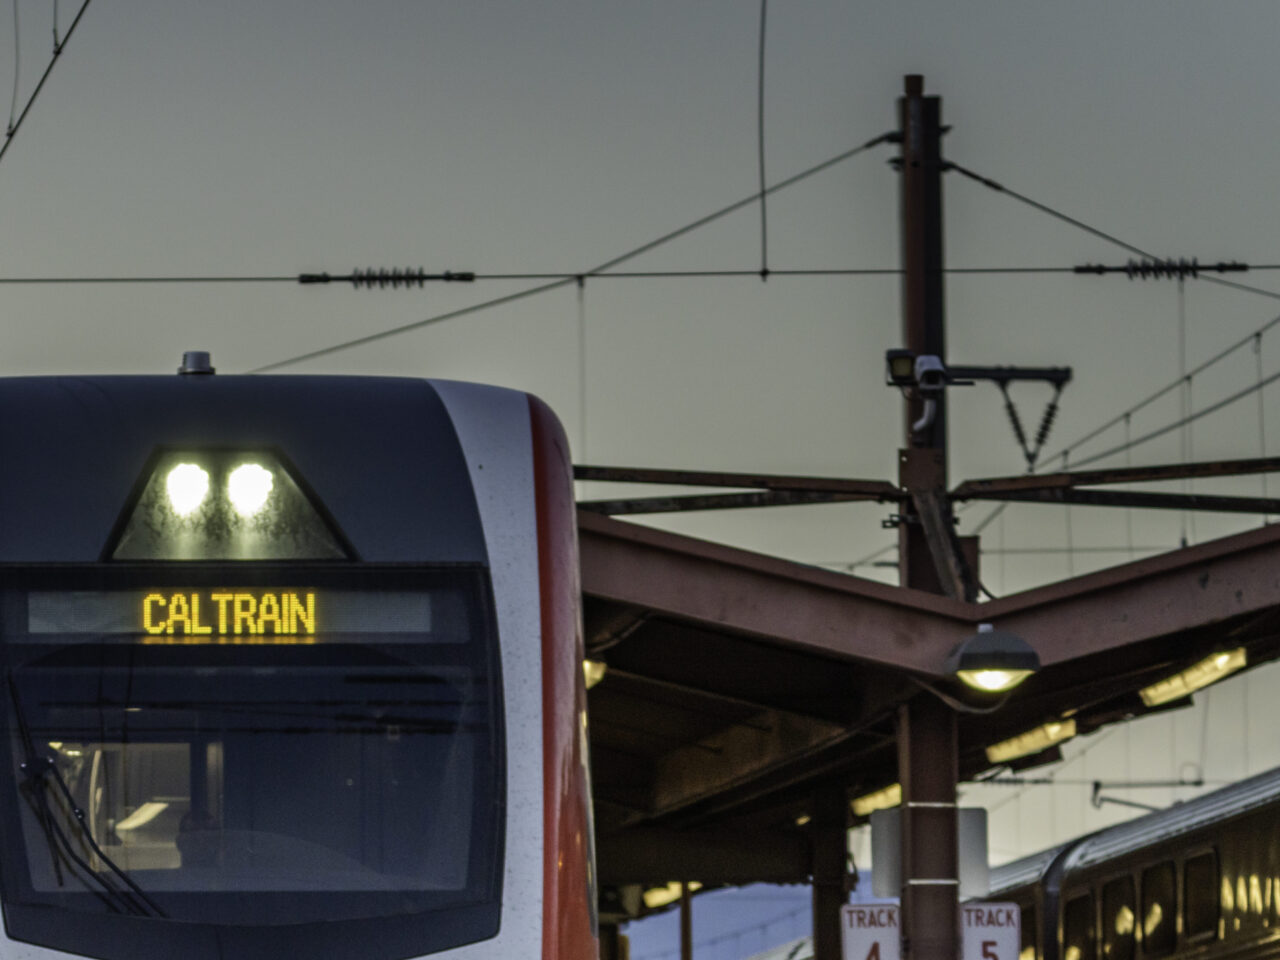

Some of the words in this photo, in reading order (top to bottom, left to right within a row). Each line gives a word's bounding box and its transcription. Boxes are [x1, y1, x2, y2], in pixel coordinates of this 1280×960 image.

[143, 593, 315, 634] CALTRAIN
[847, 909, 897, 928] TRACK
[965, 908, 1016, 927] TRACK
